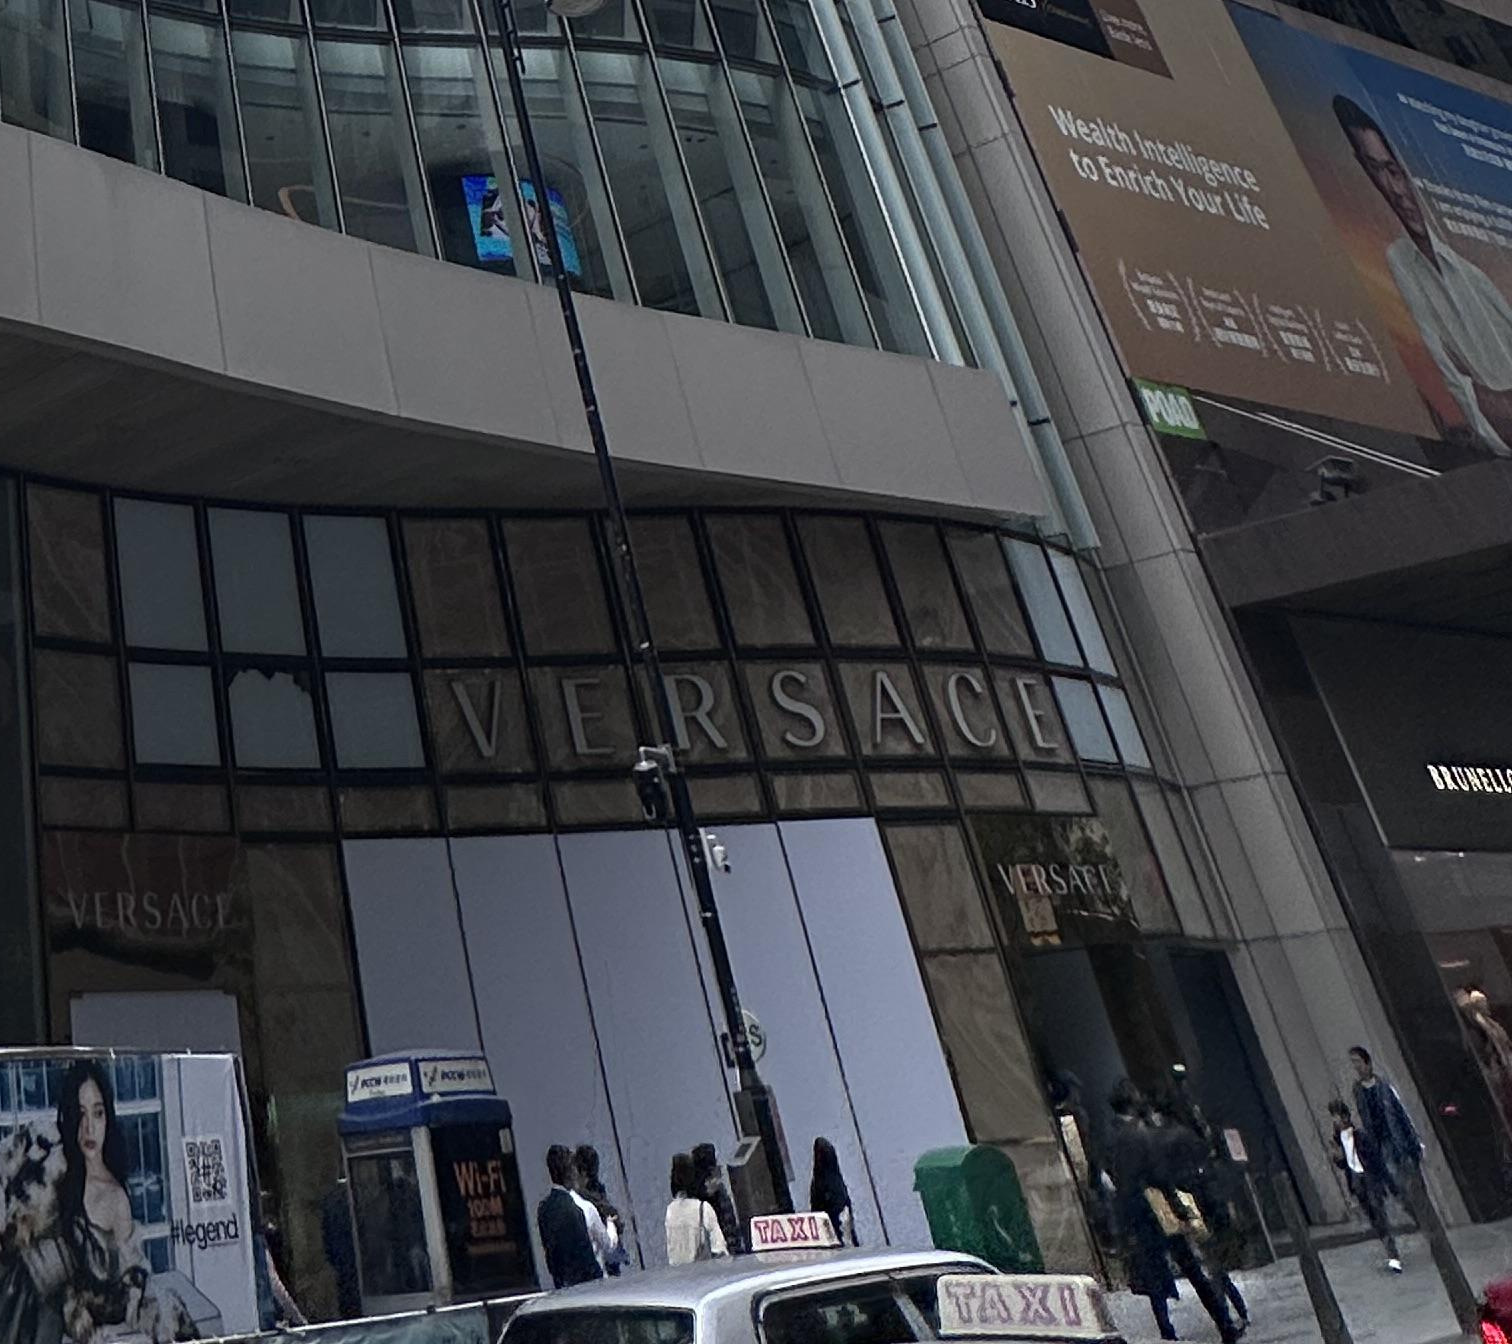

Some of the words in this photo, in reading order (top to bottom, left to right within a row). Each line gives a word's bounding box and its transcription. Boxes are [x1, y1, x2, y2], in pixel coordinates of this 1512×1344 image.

[1048, 103, 1137, 156] Wealth
[1134, 129, 1261, 193] Intelligence
[1069, 148, 1100, 182] to
[1097, 155, 1176, 202] Enrich
[1170, 175, 1226, 217] Your
[1224, 191, 1270, 230] Life
[451, 670, 1060, 758] VERSACE
[65, 890, 234, 930] VERSACE
[453, 1160, 506, 1195] Wi-Fi
[171, 1213, 239, 1250] #legend
[753, 1215, 820, 1244] TAXI
[945, 1279, 1083, 1327] TAXI
